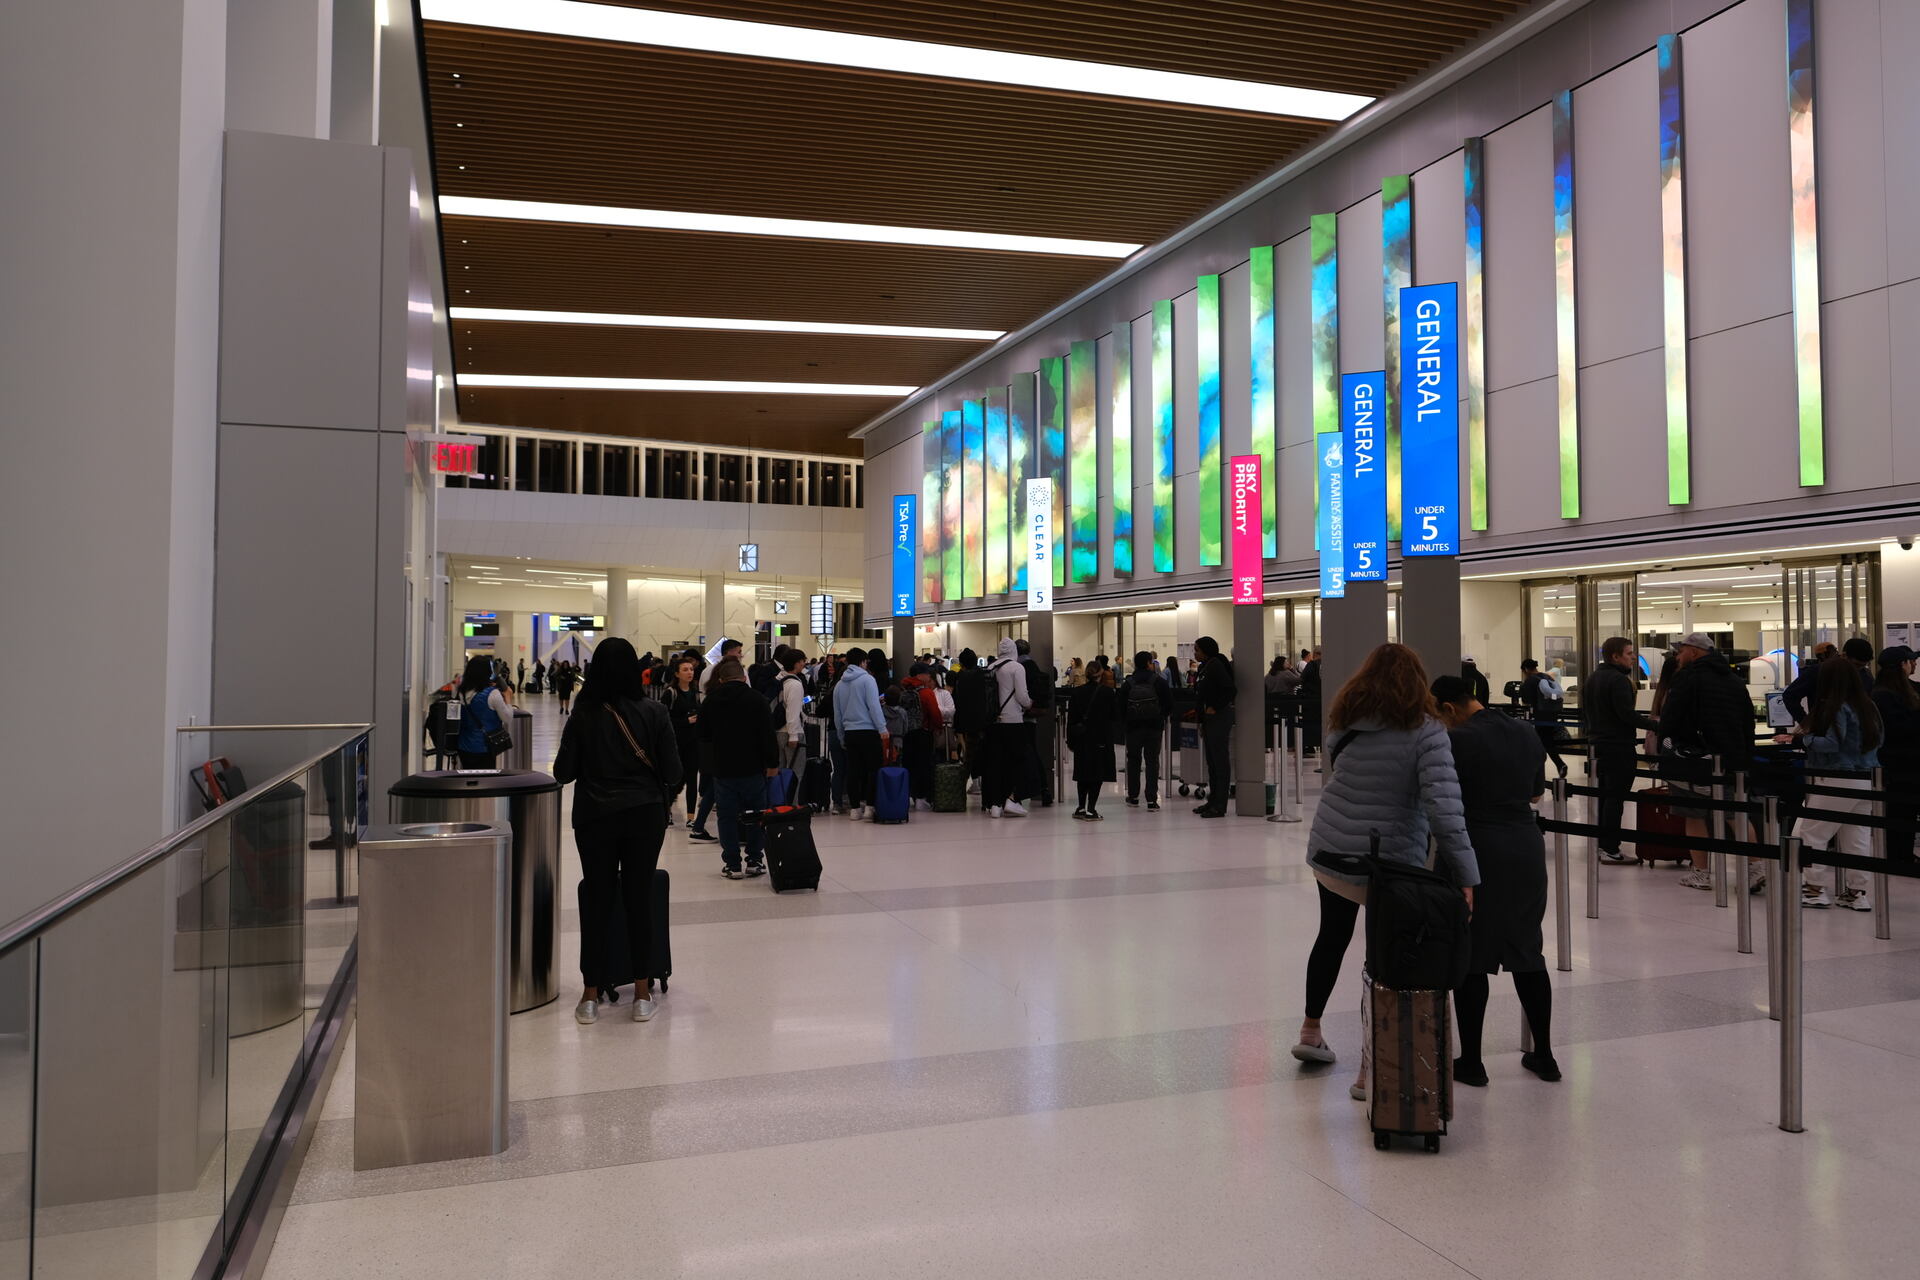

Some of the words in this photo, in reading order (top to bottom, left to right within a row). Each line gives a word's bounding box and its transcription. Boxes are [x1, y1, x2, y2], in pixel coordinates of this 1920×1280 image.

[1416, 299, 1441, 422] GENERAL
[1354, 383, 1373, 478] GENERAL
[437, 444, 476, 472] EXIT
[1246, 463, 1257, 493] SKY
[1235, 464, 1246, 533] PRIORITY
[899, 501, 909, 522] TSA
[1415, 505, 1445, 515] UNDER
[899, 524, 909, 541] Pre
[1035, 514, 1044, 560] CLEAR
[1331, 515, 1342, 553] ASSIST
[1422, 516, 1439, 541] 5
[1411, 543, 1449, 552] MINUTES
[1359, 550, 1372, 569] 5
[1332, 573, 1342, 589] 5
[1350, 570, 1380, 578] MINUTES
[1037, 591, 1043, 603] 5
[1243, 583, 1252, 597] 5
[900, 598, 907, 609] 5
